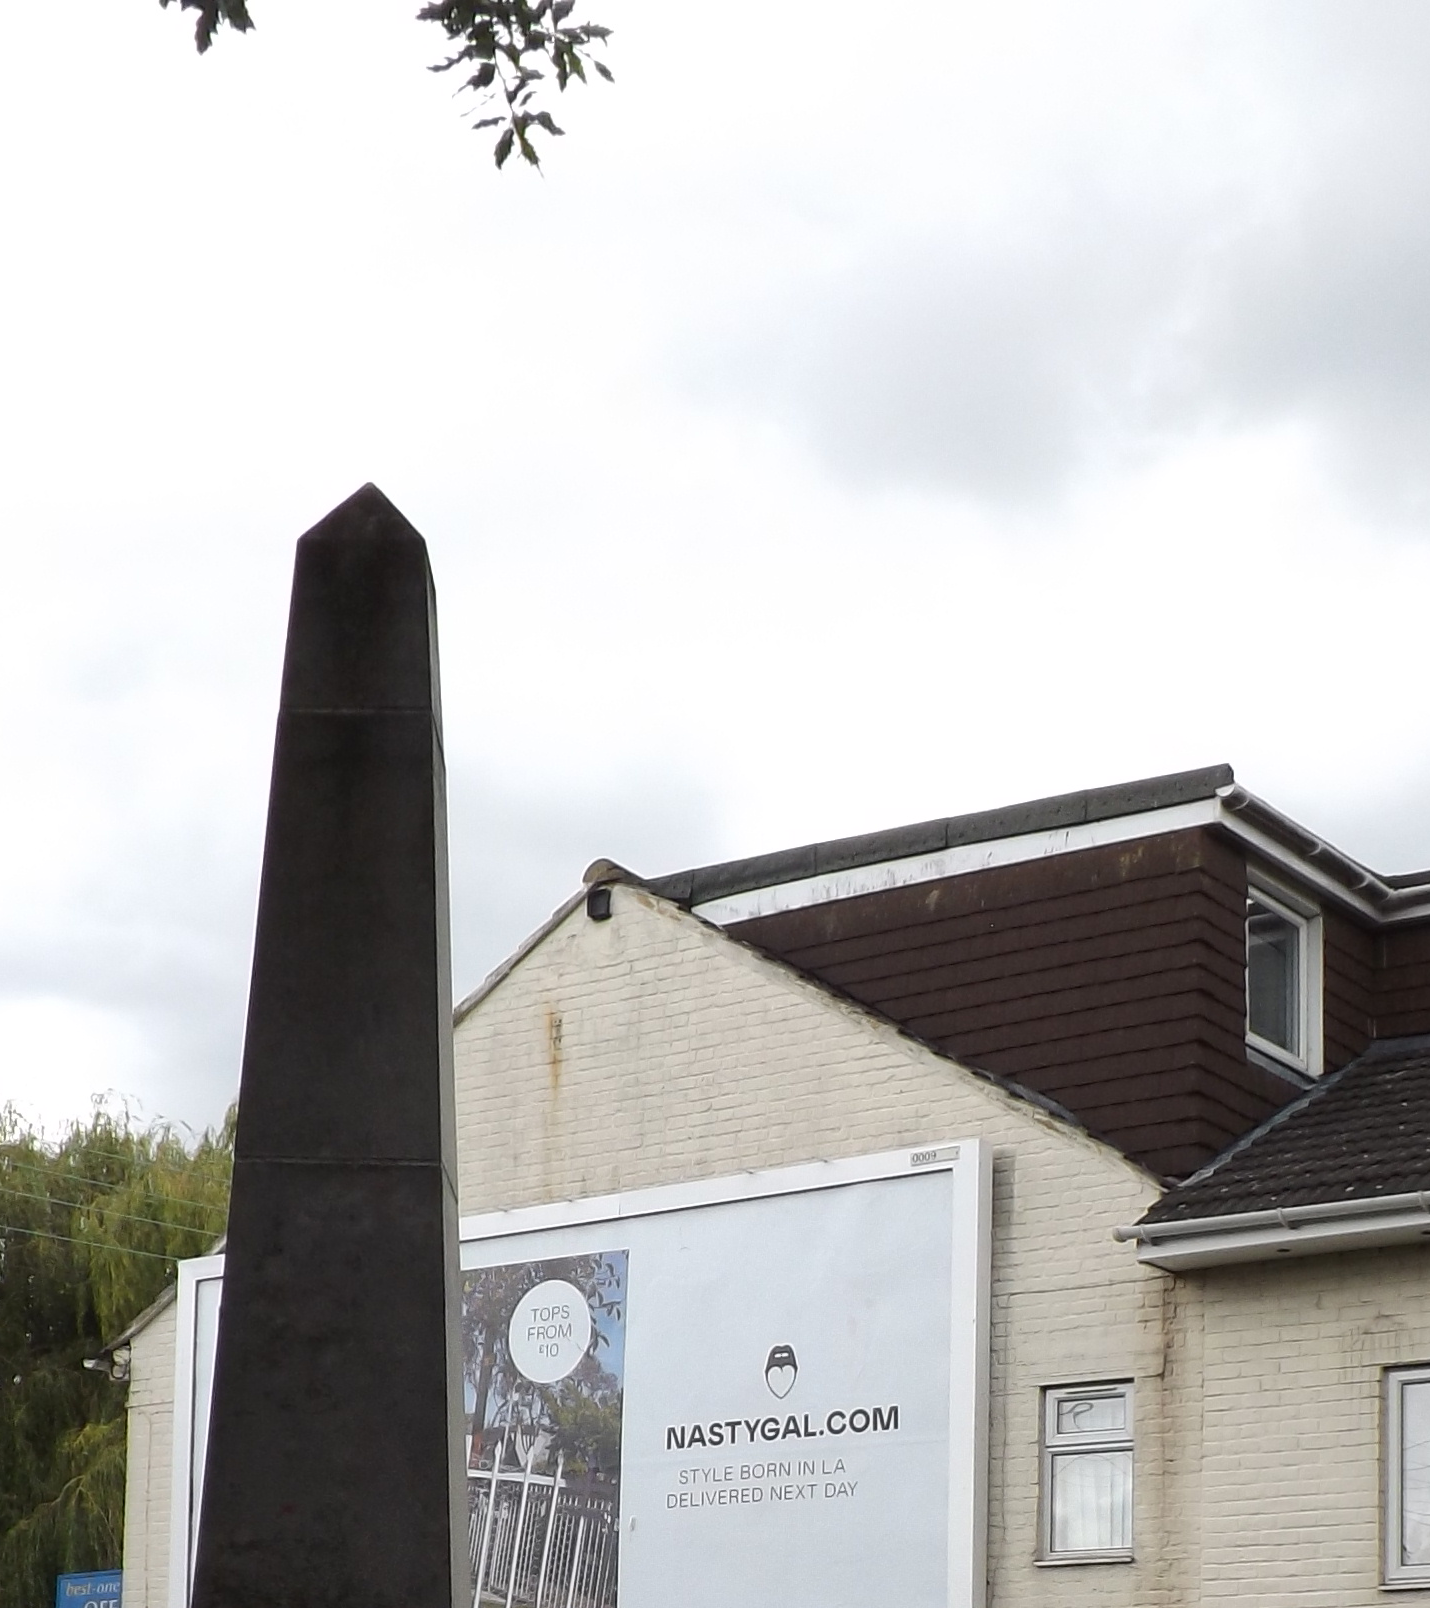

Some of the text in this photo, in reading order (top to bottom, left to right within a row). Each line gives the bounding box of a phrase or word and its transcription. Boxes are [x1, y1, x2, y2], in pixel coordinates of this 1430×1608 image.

[530, 1304, 570, 1322] TOPS
[527, 1323, 572, 1341] FROM
[538, 1342, 559, 1357] £10
[666, 1405, 900, 1450] NASTYGAL.COM
[678, 1458, 847, 1485] STYLE BORN IN LA
[666, 1481, 859, 1509] DELIVERED NEXT DAY
